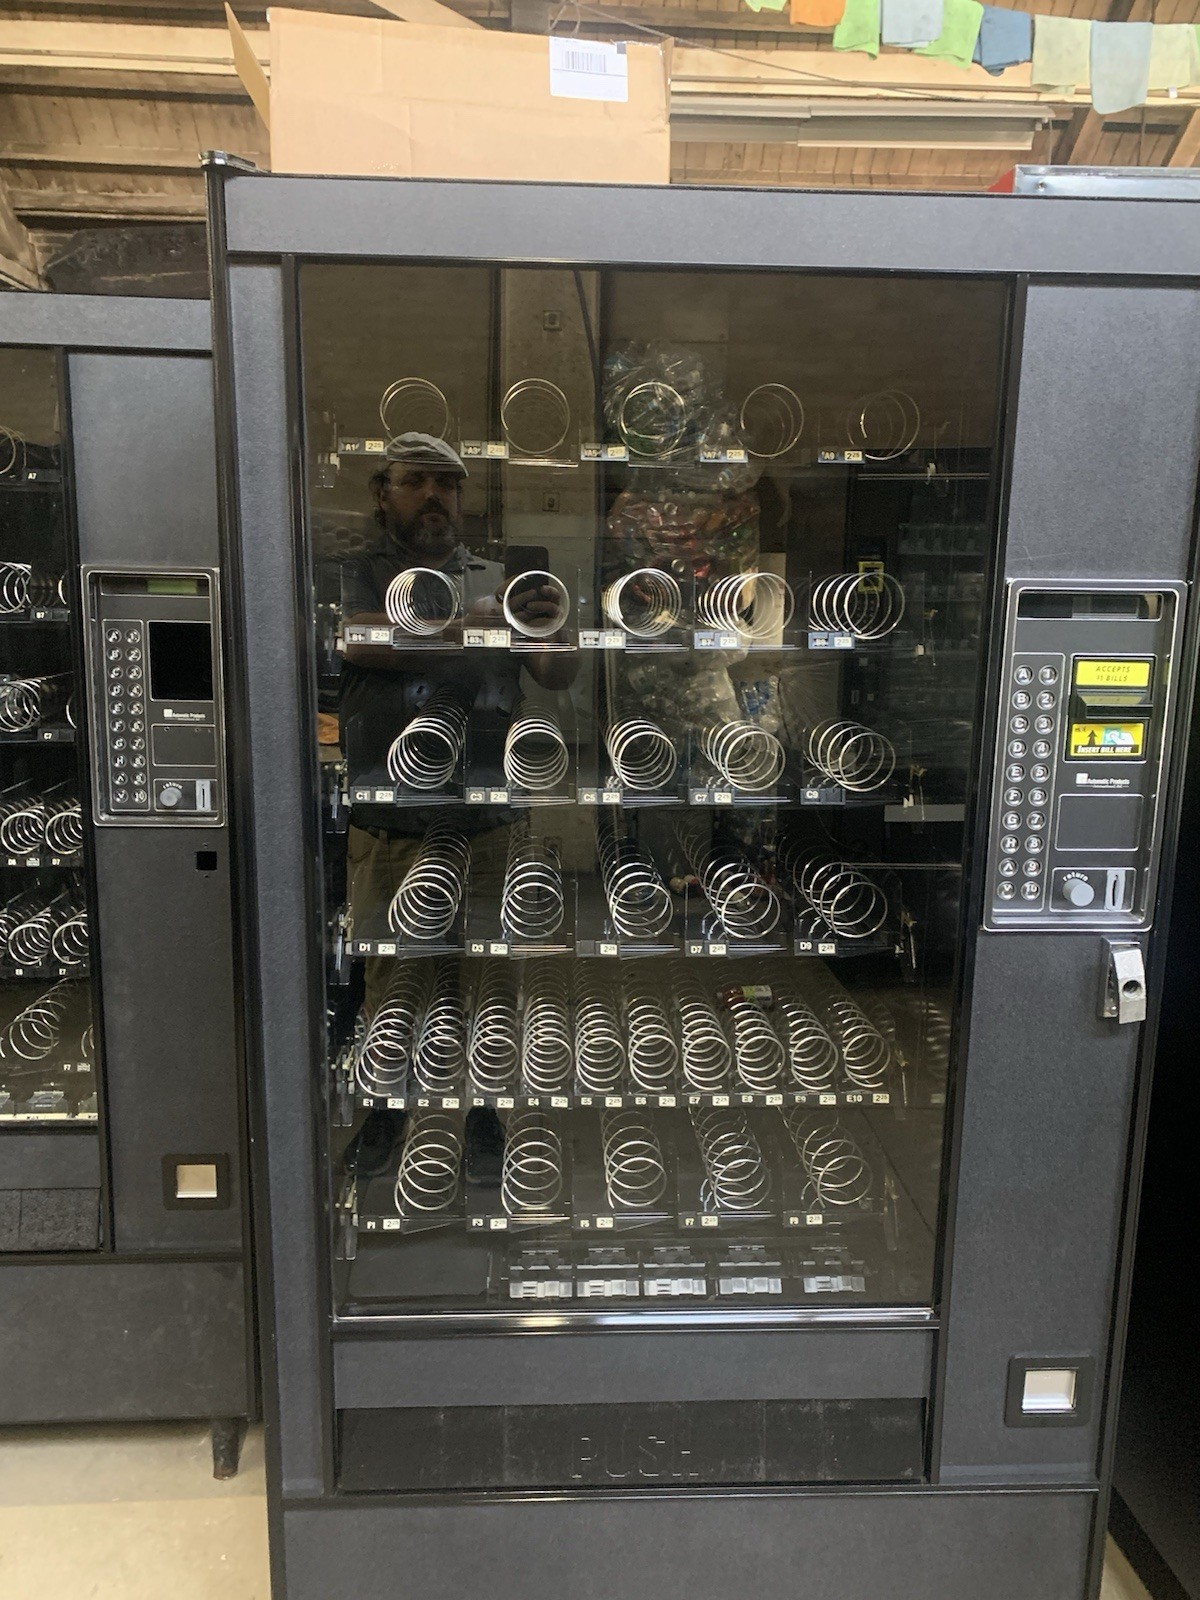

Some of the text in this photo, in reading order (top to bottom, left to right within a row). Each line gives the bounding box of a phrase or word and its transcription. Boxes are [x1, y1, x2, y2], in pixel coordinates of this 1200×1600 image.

[1077, 745, 1100, 753] INSERT
[356, 792, 368, 800] C1
[1063, 872, 1088, 881] return
[359, 943, 370, 952] D1
